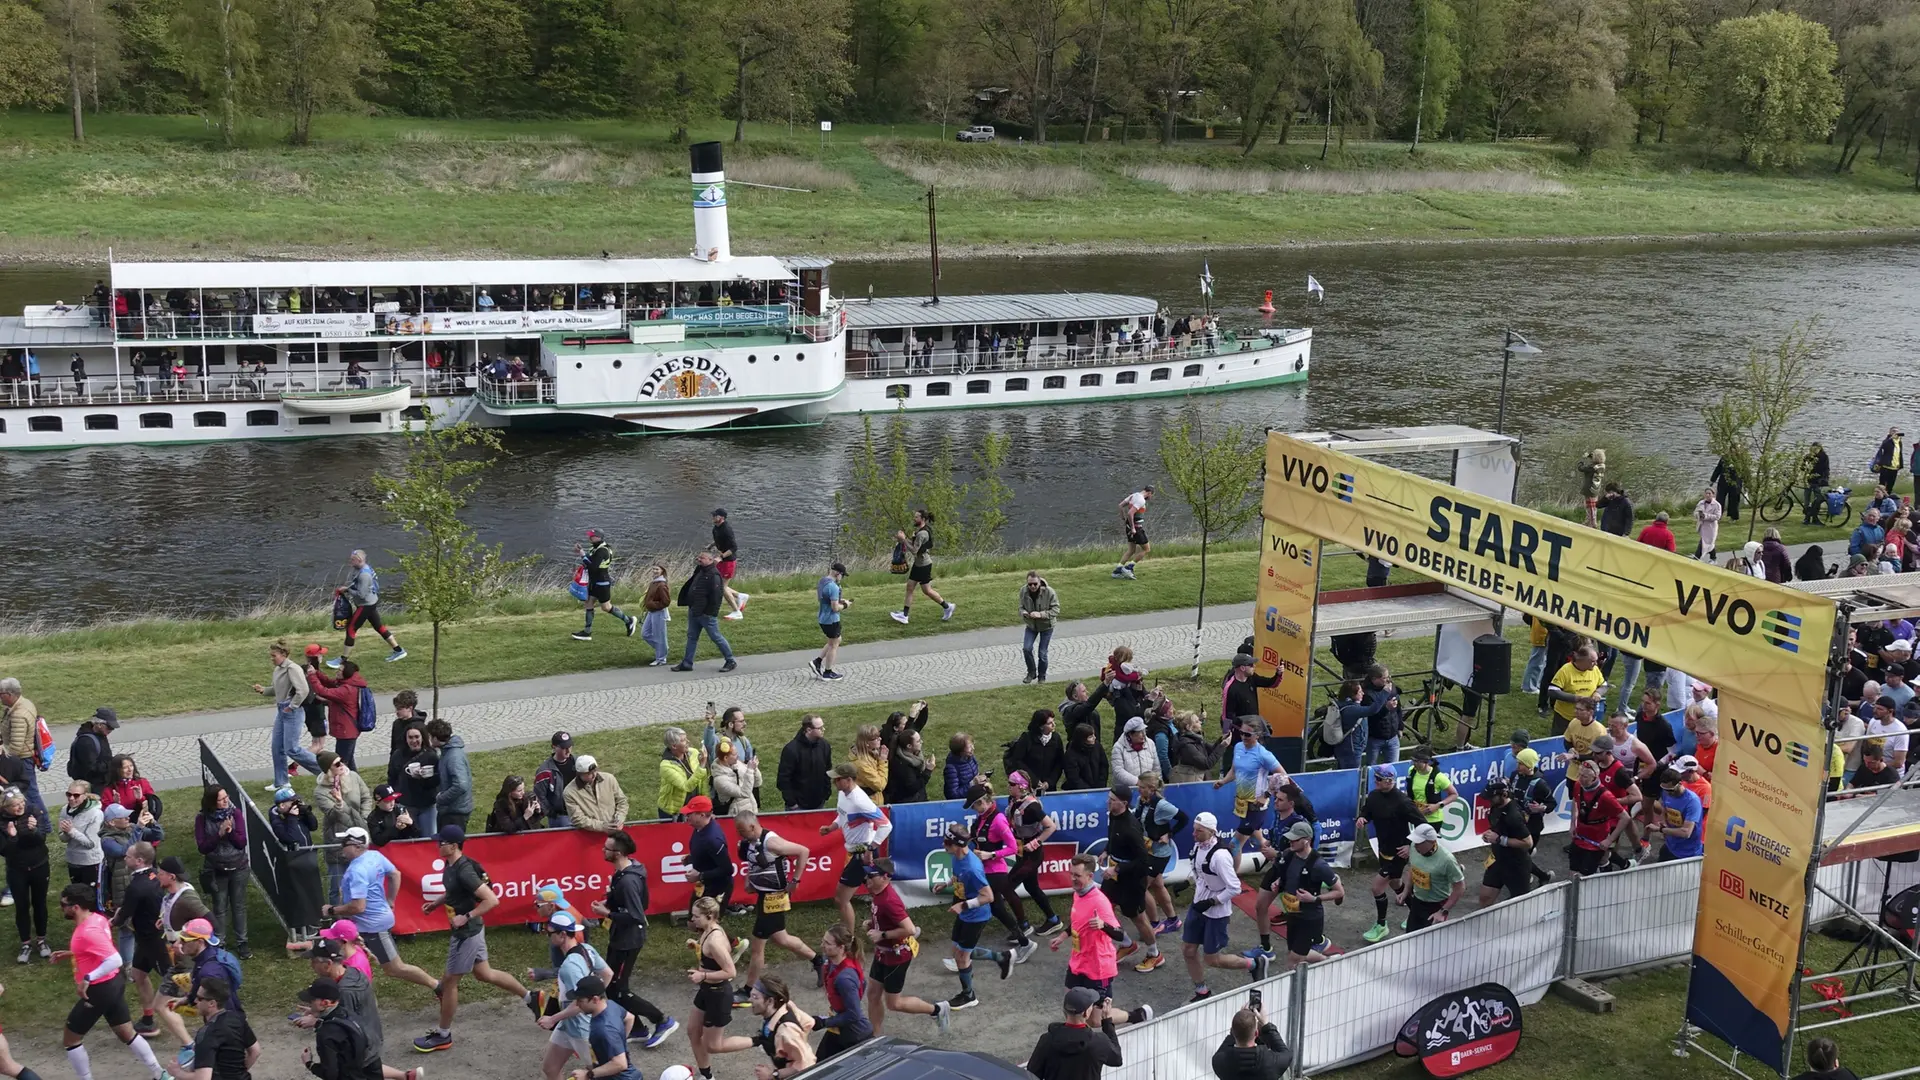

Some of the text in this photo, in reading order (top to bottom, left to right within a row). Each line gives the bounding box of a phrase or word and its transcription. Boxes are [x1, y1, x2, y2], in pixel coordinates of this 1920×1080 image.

[640, 356, 737, 398] DRESDEN
[1282, 454, 1329, 493] VVO
[1272, 535, 1298, 560] VVO
[1427, 496, 1572, 582] START
[1363, 526, 1651, 648] VVO OBERELBE-MARATHON
[1675, 579, 1756, 636] VVO
[1264, 648, 1277, 664] DB
[1731, 718, 1782, 755] VVO
[1739, 781, 1804, 815] Sparkasse Dresden
[1740, 771, 1789, 798] Ostsächsische
[1745, 841, 1782, 866] SYSTEMS
[1747, 829, 1792, 858] INTERFACE
[1037, 859, 1073, 874] ram
[491, 873, 602, 899] parksse
[1721, 871, 1743, 897] DB
[1749, 888, 1790, 920] NETZE
[1714, 918, 1785, 964] SchillerGarten
